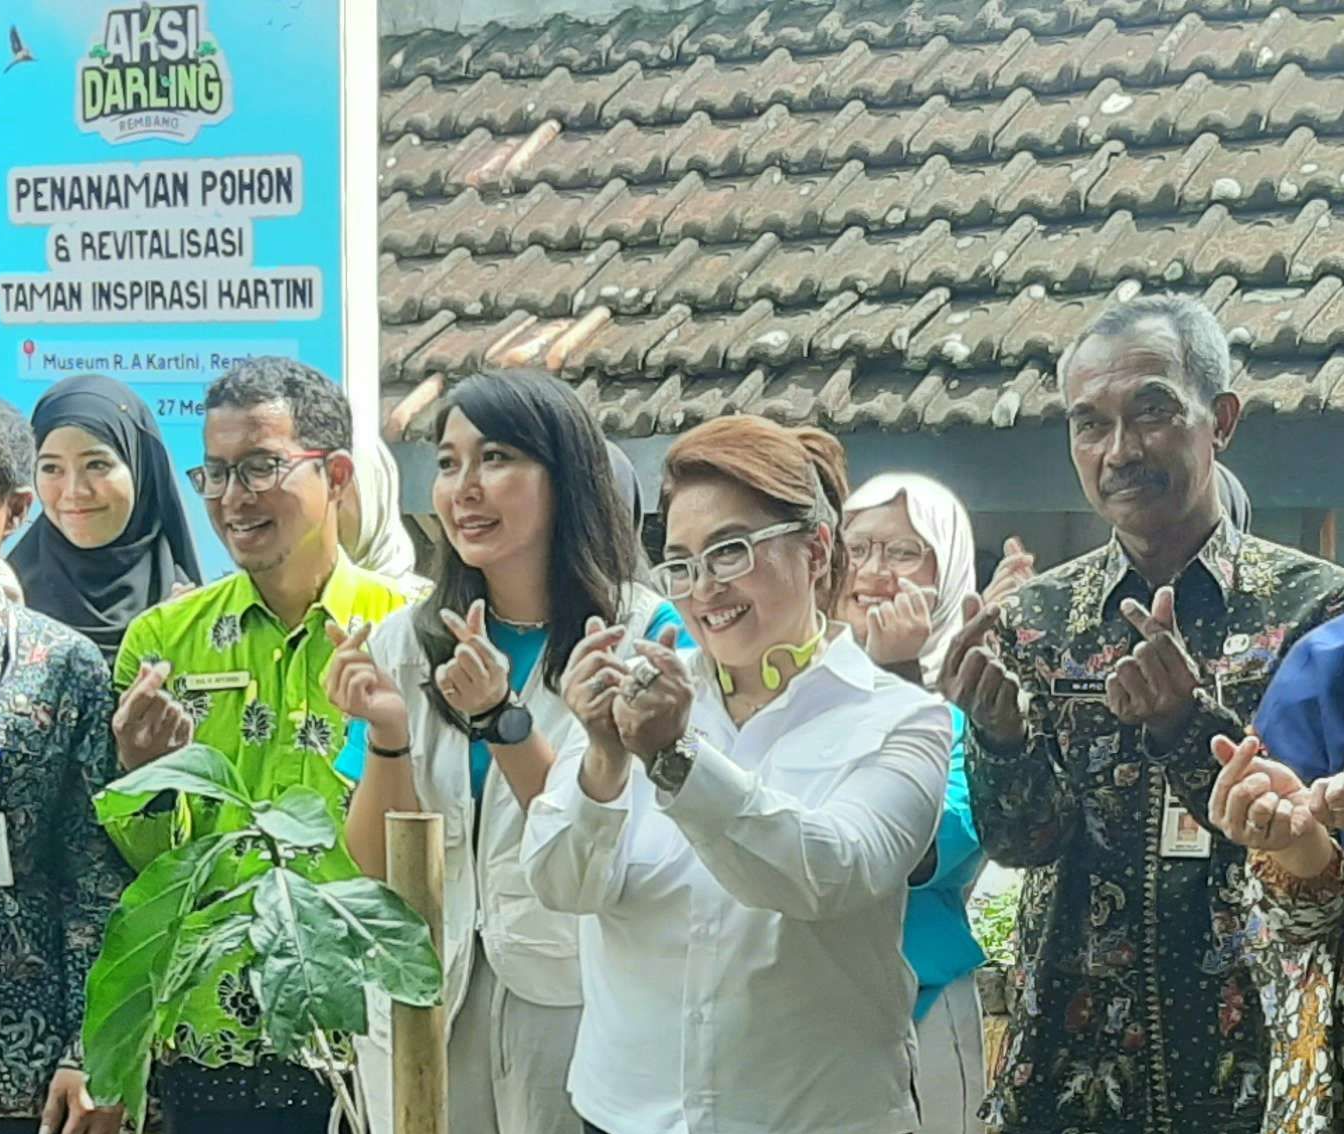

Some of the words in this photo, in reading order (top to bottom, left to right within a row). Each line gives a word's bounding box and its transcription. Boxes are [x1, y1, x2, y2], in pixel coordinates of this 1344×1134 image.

[105, 7, 198, 64] AKSI
[83, 60, 222, 122] DARLING
[15, 171, 189, 213] PENANAMAN
[200, 167, 293, 208] POHON
[54, 234, 71, 262] &
[81, 227, 244, 261] REVITALISASI
[1, 282, 82, 312] TAMAN
[92, 279, 208, 311] INSPIRASI
[218, 277, 314, 310] KARTINI
[43, 353, 110, 370] Museum
[146, 352, 205, 373] Kartini,
[158, 399, 176, 416] 27
